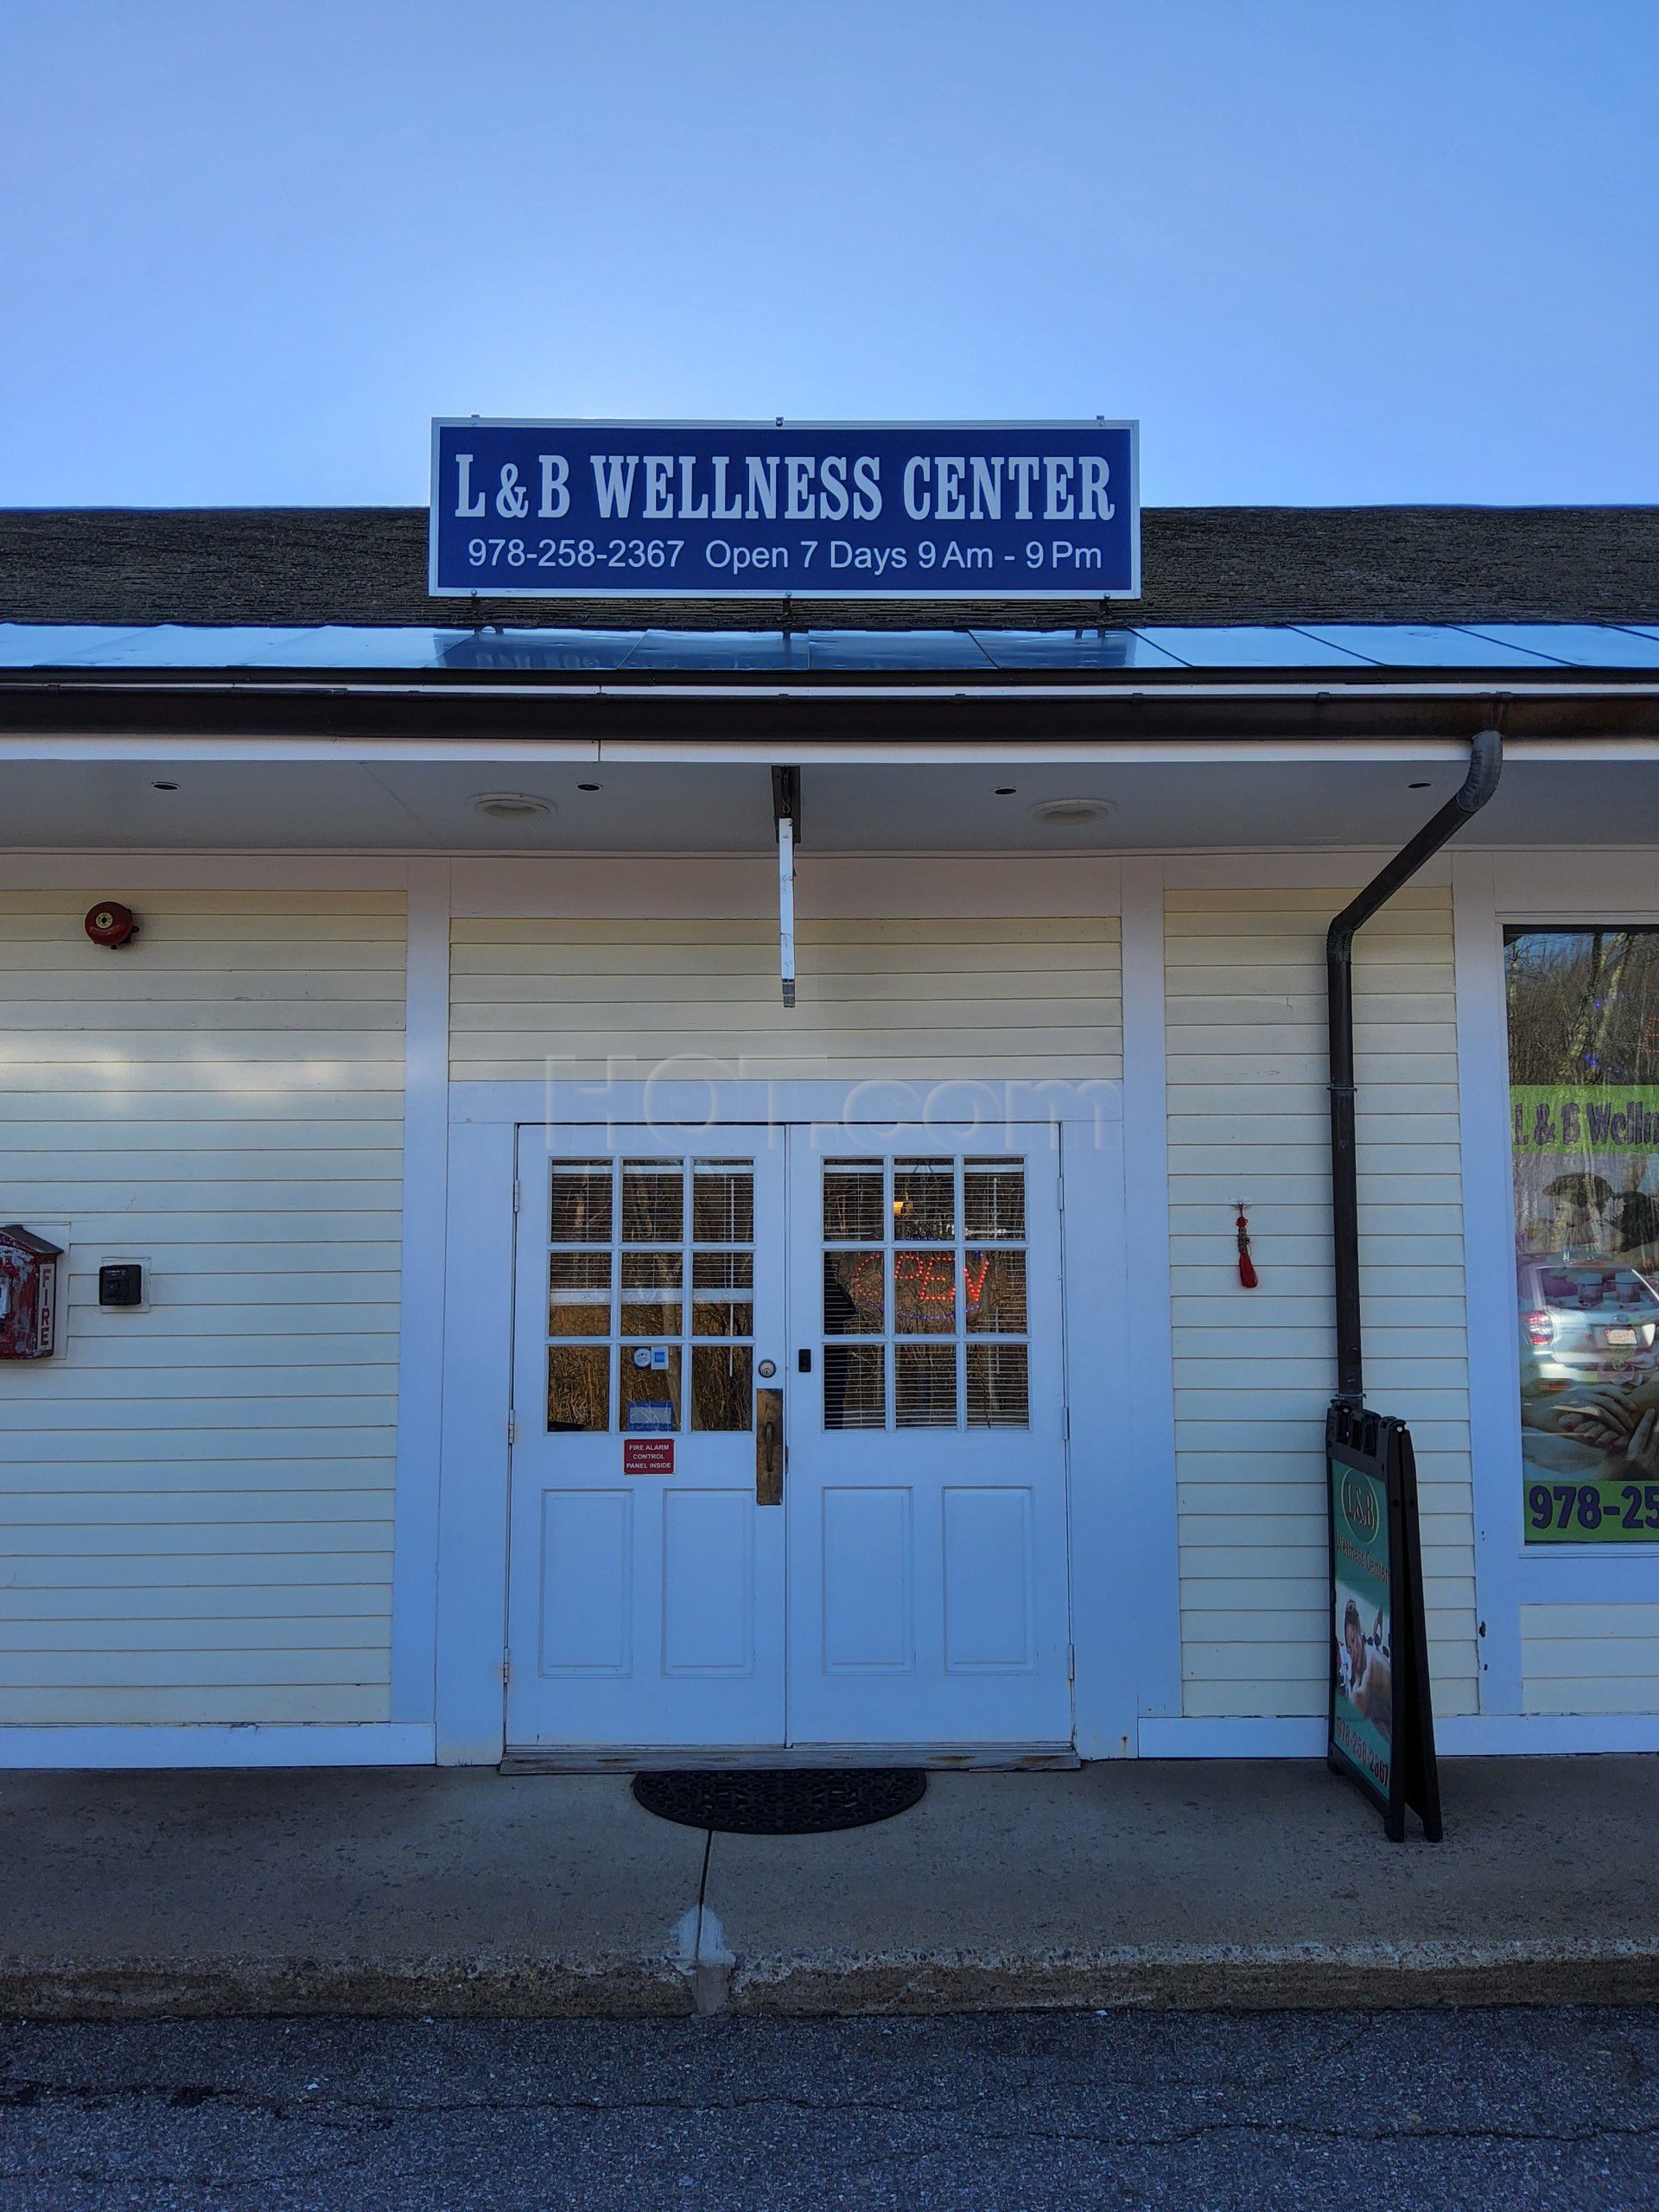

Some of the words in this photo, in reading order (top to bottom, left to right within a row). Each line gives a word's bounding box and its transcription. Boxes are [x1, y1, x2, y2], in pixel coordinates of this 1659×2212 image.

[454, 454, 486, 518] L
[496, 462, 529, 518] &
[537, 454, 570, 518] B
[589, 454, 883, 521] WELLNESS
[903, 455, 1116, 521] CENTER
[468, 538, 685, 568] 978-258-2367
[705, 539, 789, 575] Open
[800, 541, 818, 568] 7
[830, 541, 907, 575] Days
[1561, 1102, 1580, 1146] B
